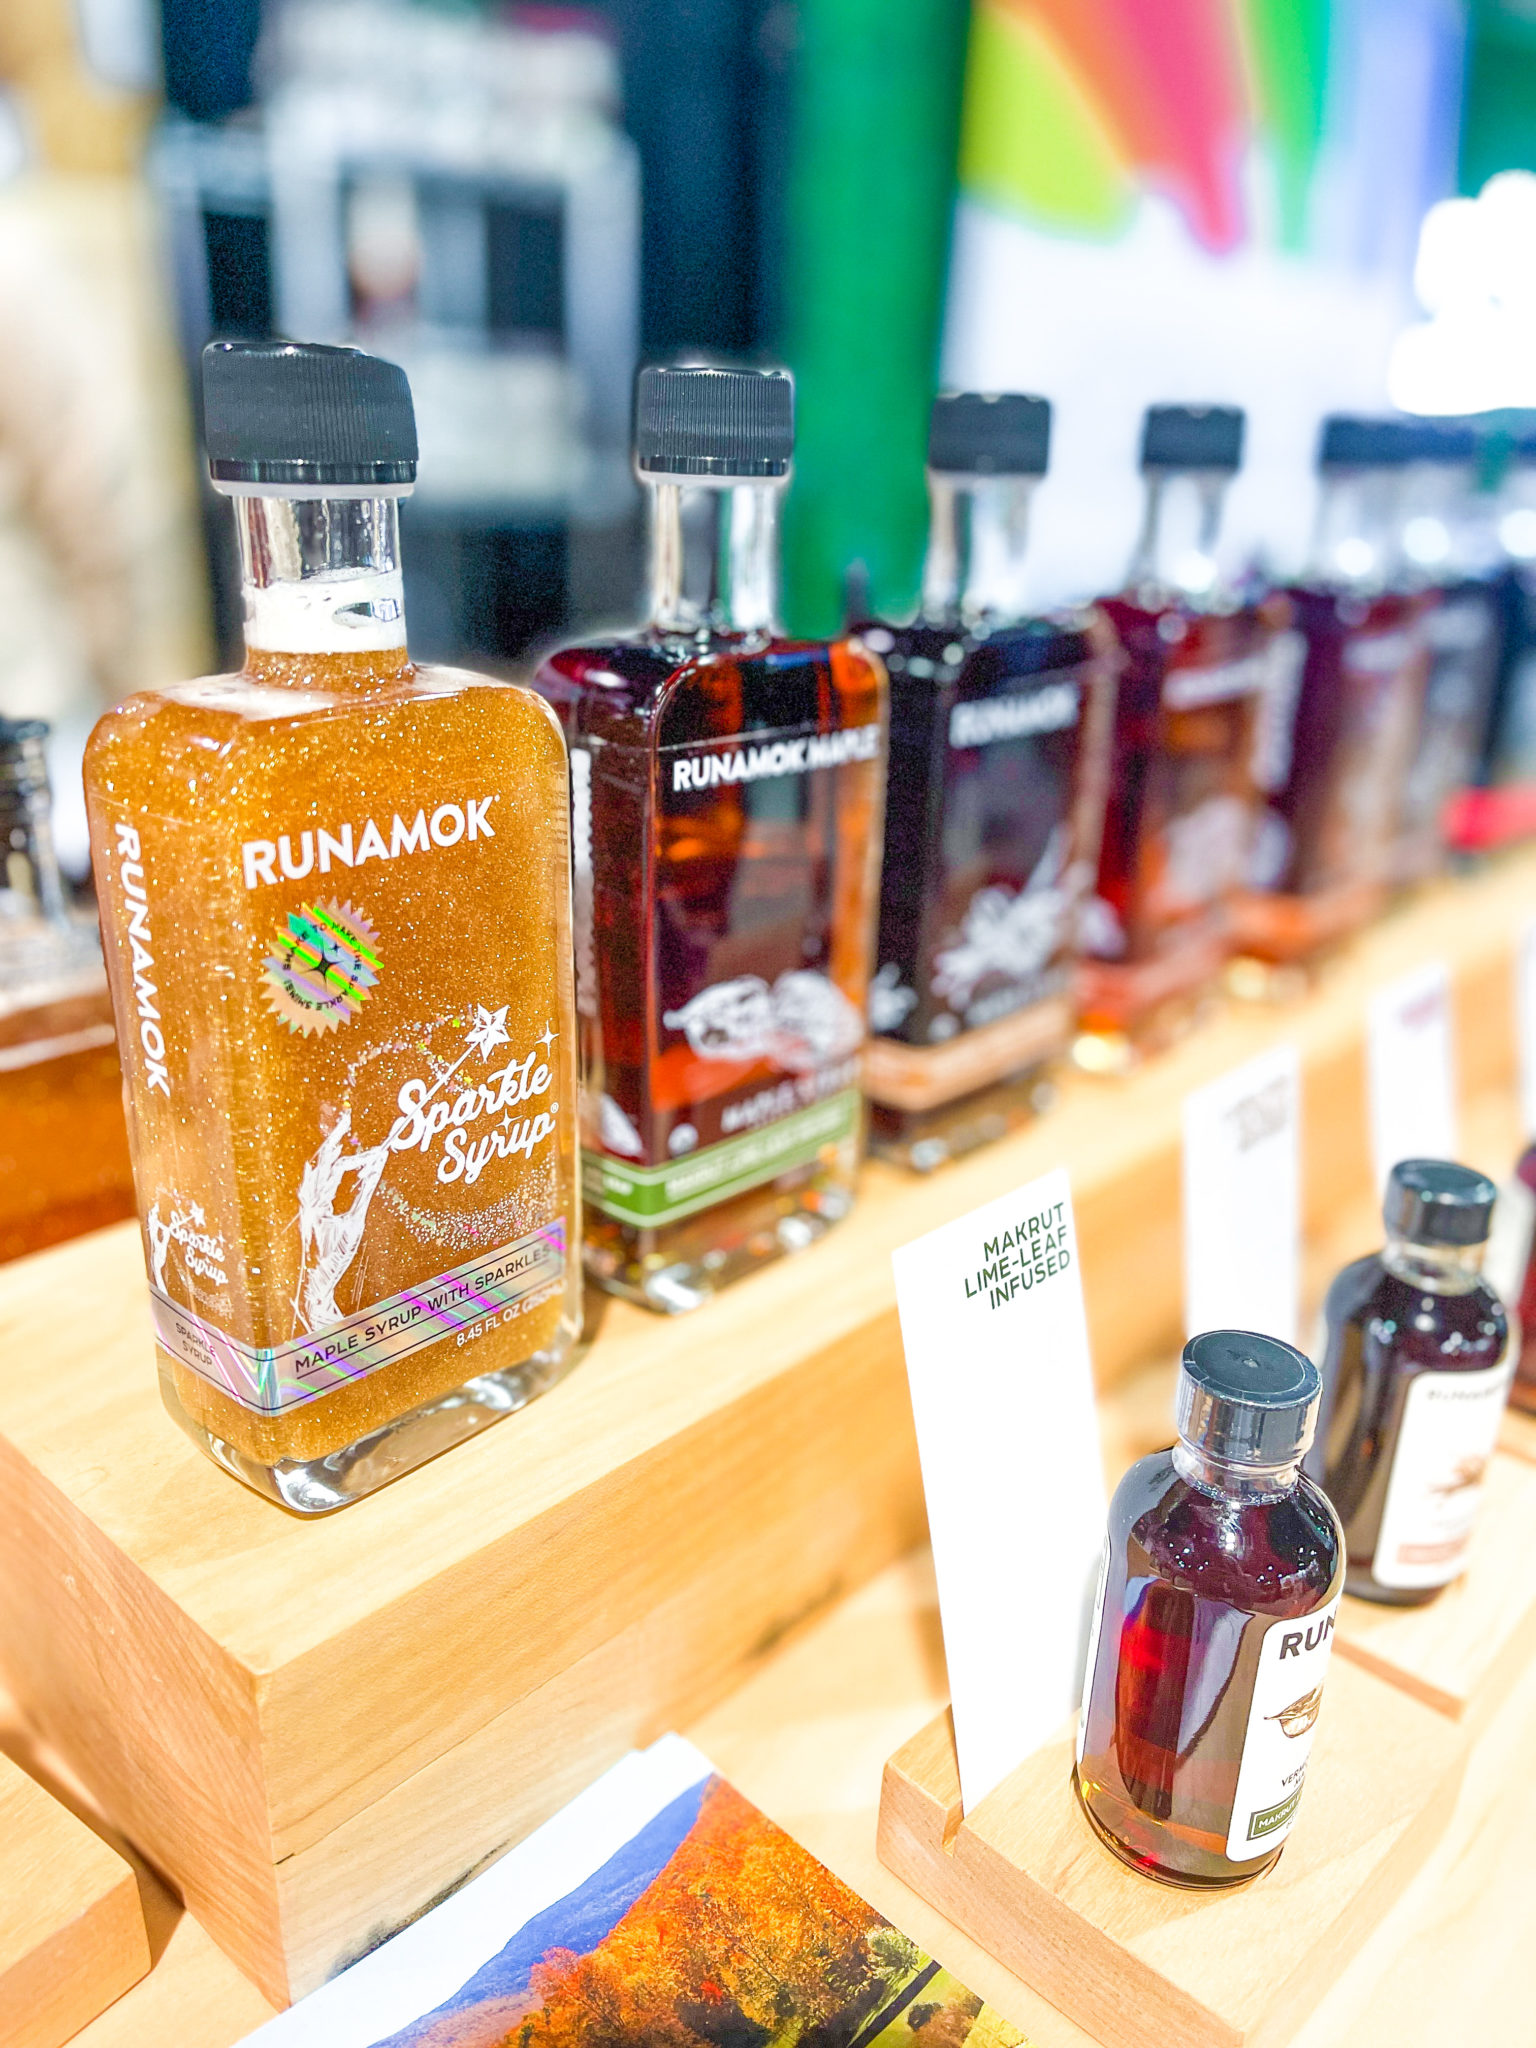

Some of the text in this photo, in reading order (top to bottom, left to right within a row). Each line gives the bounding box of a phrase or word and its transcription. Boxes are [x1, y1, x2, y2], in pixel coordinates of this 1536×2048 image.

[673, 735, 807, 791] RUNAMOK
[242, 796, 497, 889] RUNAMOK
[114, 822, 170, 1097] RUNAMOK
[389, 1051, 553, 1153] Sparkle
[169, 1210, 226, 1263] Sparkle
[964, 1225, 1067, 1298] LIME-LEAF
[983, 1202, 1064, 1262] MAKRUT
[185, 1246, 228, 1286] Syrup
[990, 1250, 1070, 1310] INFUSED
[295, 1244, 552, 1373] MAPLE SYRUP WITH SPARKLES
[456, 1303, 520, 1347] 8.45 FL OZ
[176, 1322, 216, 1358] SPARKLE
[182, 1340, 213, 1366] SYRUP
